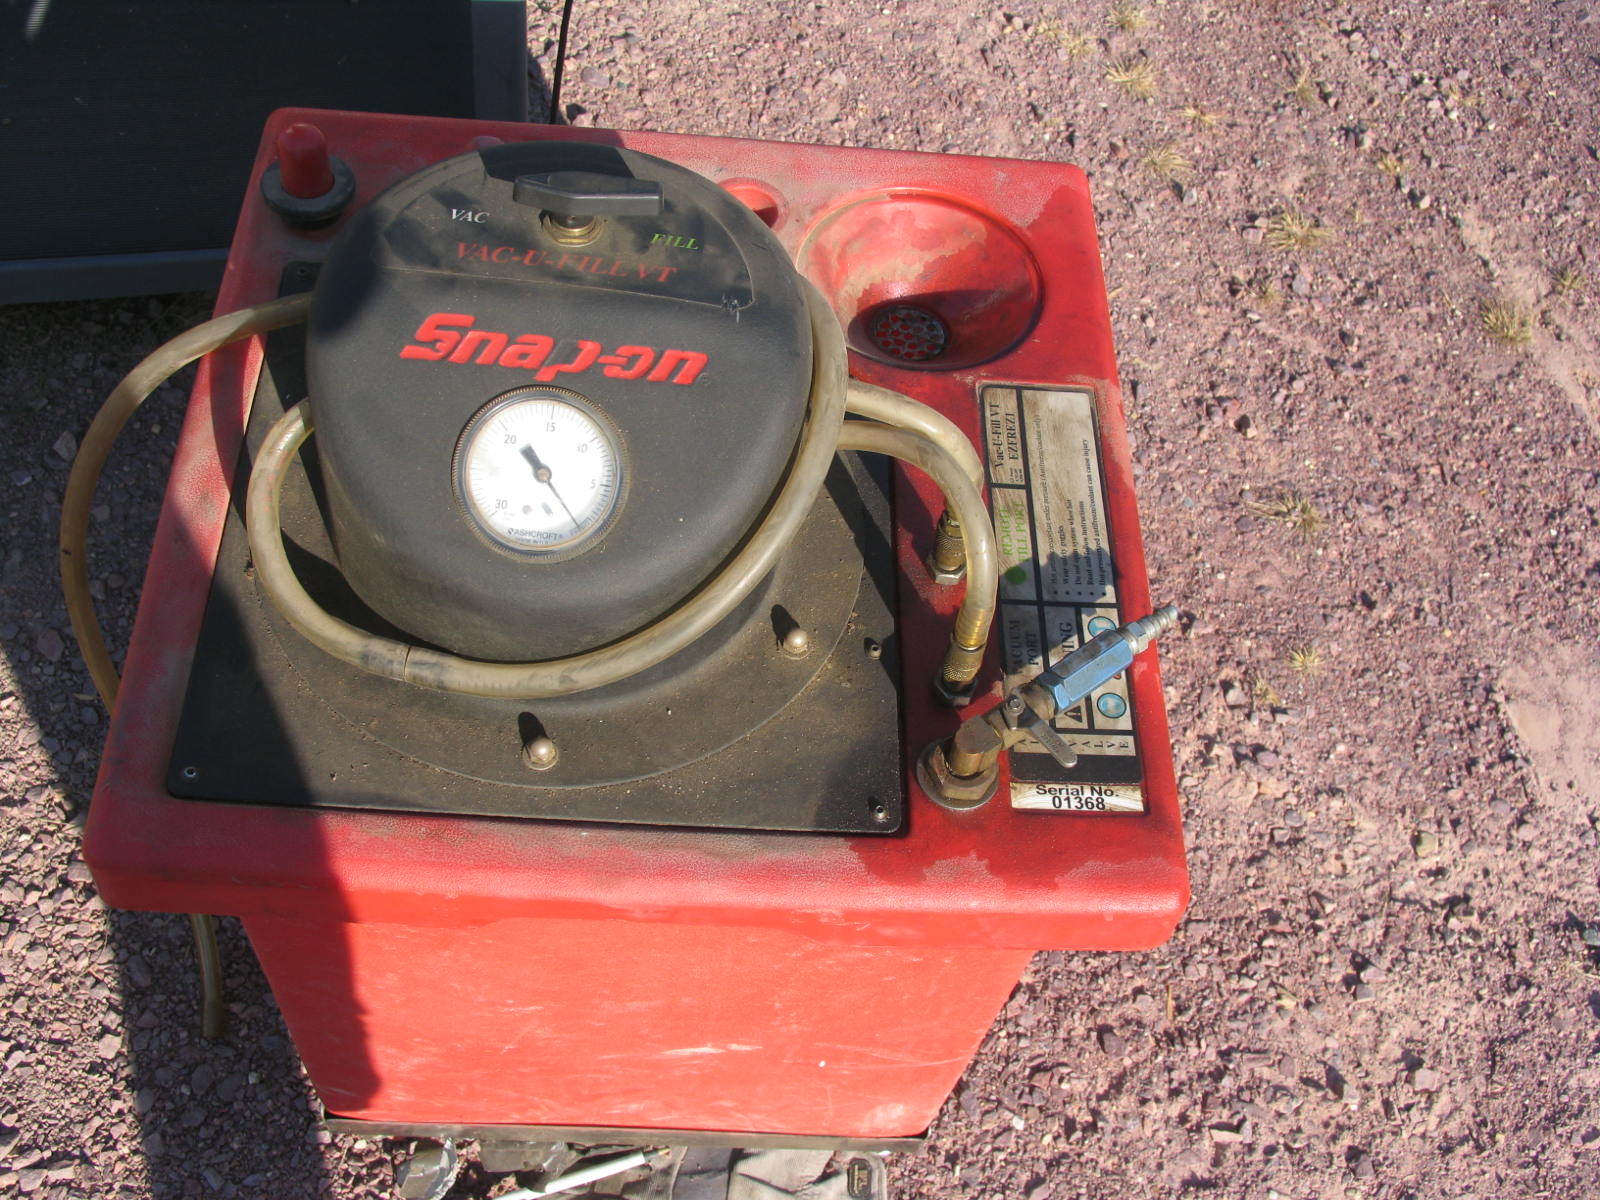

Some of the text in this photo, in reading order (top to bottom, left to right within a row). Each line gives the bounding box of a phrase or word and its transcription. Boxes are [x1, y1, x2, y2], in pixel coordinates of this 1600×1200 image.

[451, 207, 490, 224] VAC
[650, 233, 700, 250] FILL
[455, 241, 678, 283] VAC-U-FILL VT
[400, 312, 709, 386] Snap-on
[546, 422, 557, 432] 15
[504, 434, 517, 444] 20
[989, 403, 1004, 468] Vac-U-Fill VT
[577, 444, 588, 453] 10
[590, 479, 597, 489] 5
[495, 499, 508, 509] 30
[1012, 502, 1026, 532] PORT
[1024, 632, 1039, 665] PORT
[1036, 784, 1119, 797] Serial No.
[1052, 796, 1106, 810] 01368
